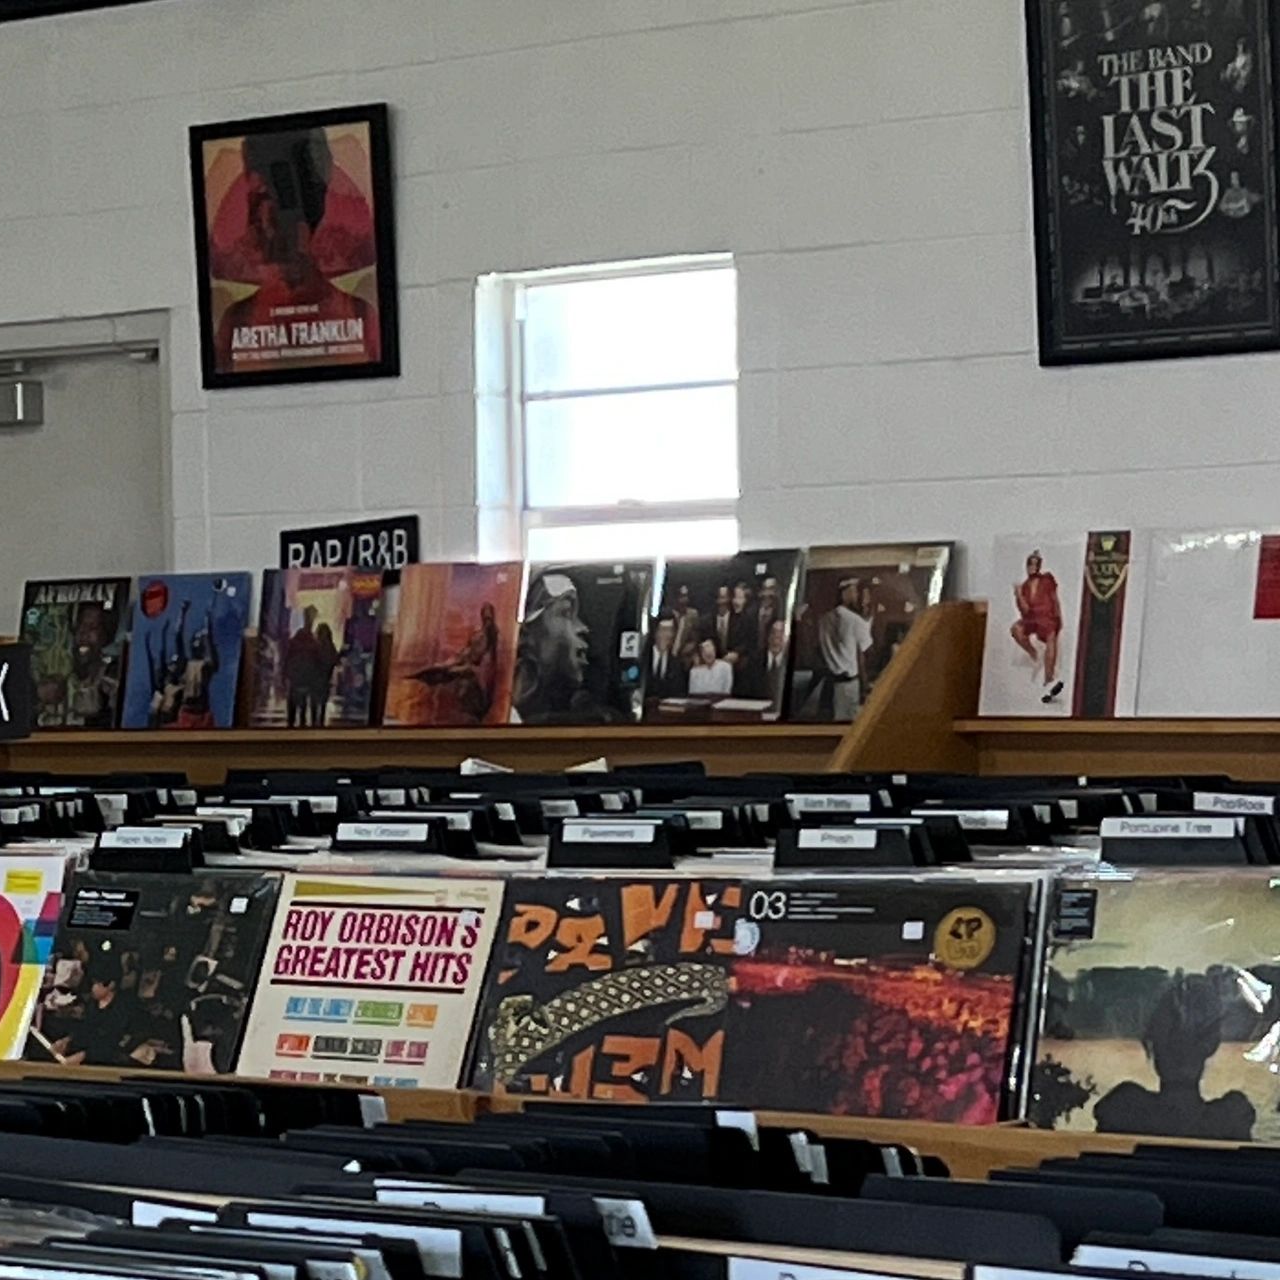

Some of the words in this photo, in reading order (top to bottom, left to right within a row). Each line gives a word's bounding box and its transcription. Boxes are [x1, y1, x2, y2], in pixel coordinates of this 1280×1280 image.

[1098, 50, 1144, 77] THE
[1149, 42, 1213, 71] BAND
[1108, 66, 1197, 113] THE
[1102, 102, 1216, 159] LAST
[231, 324, 289, 350] ARETHA
[290, 317, 364, 345] FRANKLIN
[1185, 822, 1212, 834] Tree
[282, 909, 334, 942] ROY
[273, 944, 406, 983] GREATEST
[409, 951, 473, 985] HITS
